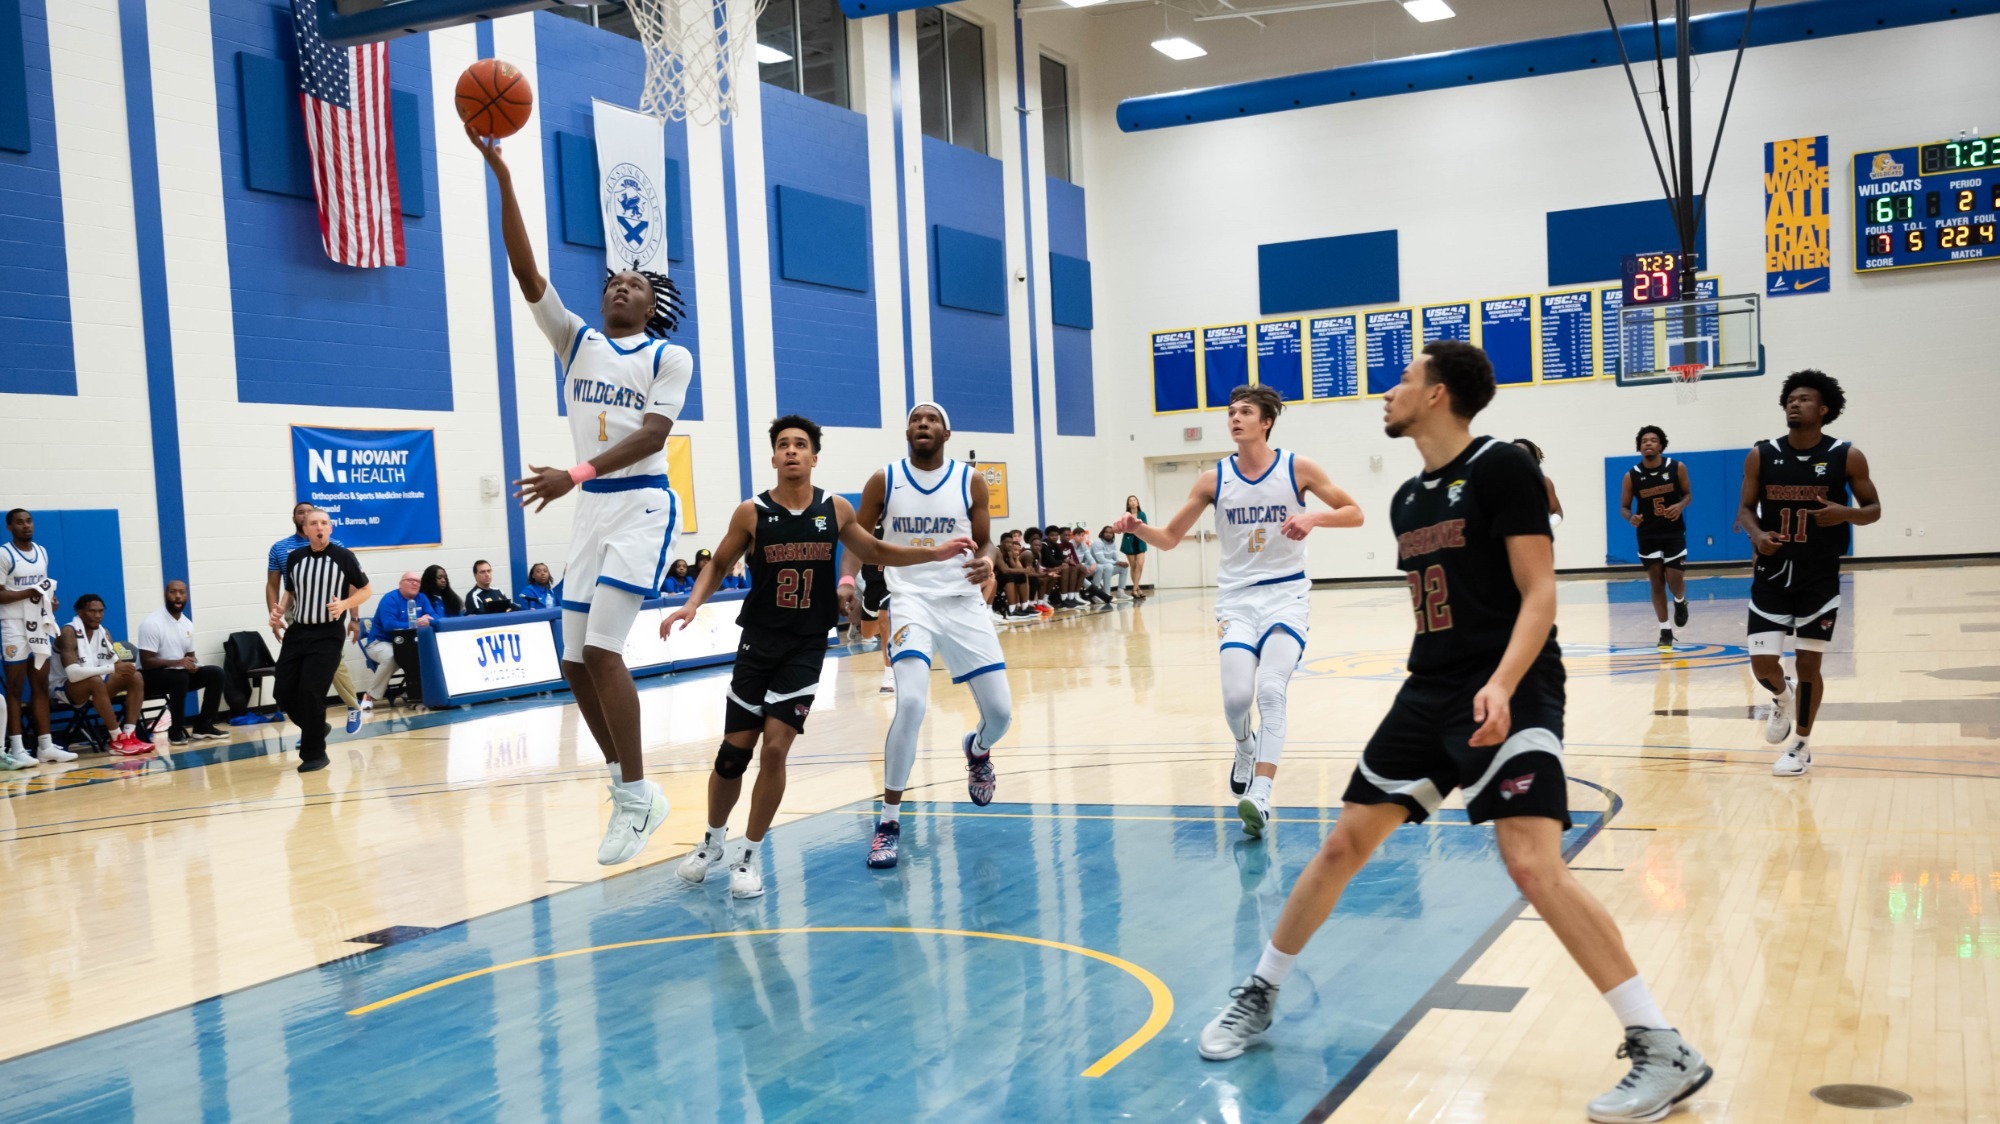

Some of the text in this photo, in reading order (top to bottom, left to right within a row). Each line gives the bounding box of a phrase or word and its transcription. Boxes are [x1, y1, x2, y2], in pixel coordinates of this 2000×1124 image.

[1774, 137, 1816, 171] BE
[1765, 167, 1829, 194] WARE
[1859, 179, 1922, 196] WILDCATS
[1950, 179, 1982, 189] PERIOD
[1766, 187, 1829, 225] ALL
[1877, 197, 1912, 222] 61
[1959, 191, 1972, 211] 2
[1904, 222, 1926, 231] T.O.L.
[1936, 214, 1996, 228] PLAYER FOUL
[1766, 217, 1830, 253] THAT
[1866, 225, 1893, 235] FOULS
[1942, 226, 1968, 248] 22
[1980, 225, 1993, 242] 4
[1879, 235, 1890, 252] 7
[1910, 232, 1922, 251] 5
[1766, 248, 1830, 273] ENTER
[1951, 249, 1982, 259] MATCH
[1638, 255, 1674, 271] 7:23
[1866, 258, 1894, 268] SCORE
[1634, 272, 1668, 300] 27
[1486, 299, 1526, 311] USCAA
[1545, 294, 1587, 306] USCAA
[1369, 312, 1408, 323] USCAA
[1426, 306, 1466, 317] USCAA
[1260, 322, 1297, 333] USCAA
[1314, 318, 1352, 328] USCAA
[1156, 332, 1191, 343] USCAA
[1207, 327, 1243, 338] USCAA
[574, 378, 645, 410] WILDCATS
[598, 411, 608, 441] 1
[352, 450, 409, 465] NOVANT
[352, 468, 406, 483] HEALTH
[312, 492, 350, 501] Orthopedics
[356, 492, 374, 501] Sports
[375, 491, 402, 499] Medicine
[403, 491, 424, 499] Institute
[345, 517, 368, 526] Barron,
[369, 516, 380, 525] MD
[1226, 505, 1287, 525] WILDCATS
[892, 516, 956, 534] WILDCATS
[1780, 508, 1808, 543] 11
[1247, 529, 1266, 553] 15
[764, 542, 832, 563] ERSKINE
[777, 568, 813, 609] 21
[1407, 564, 1453, 634] 22
[476, 634, 521, 667] JWU
